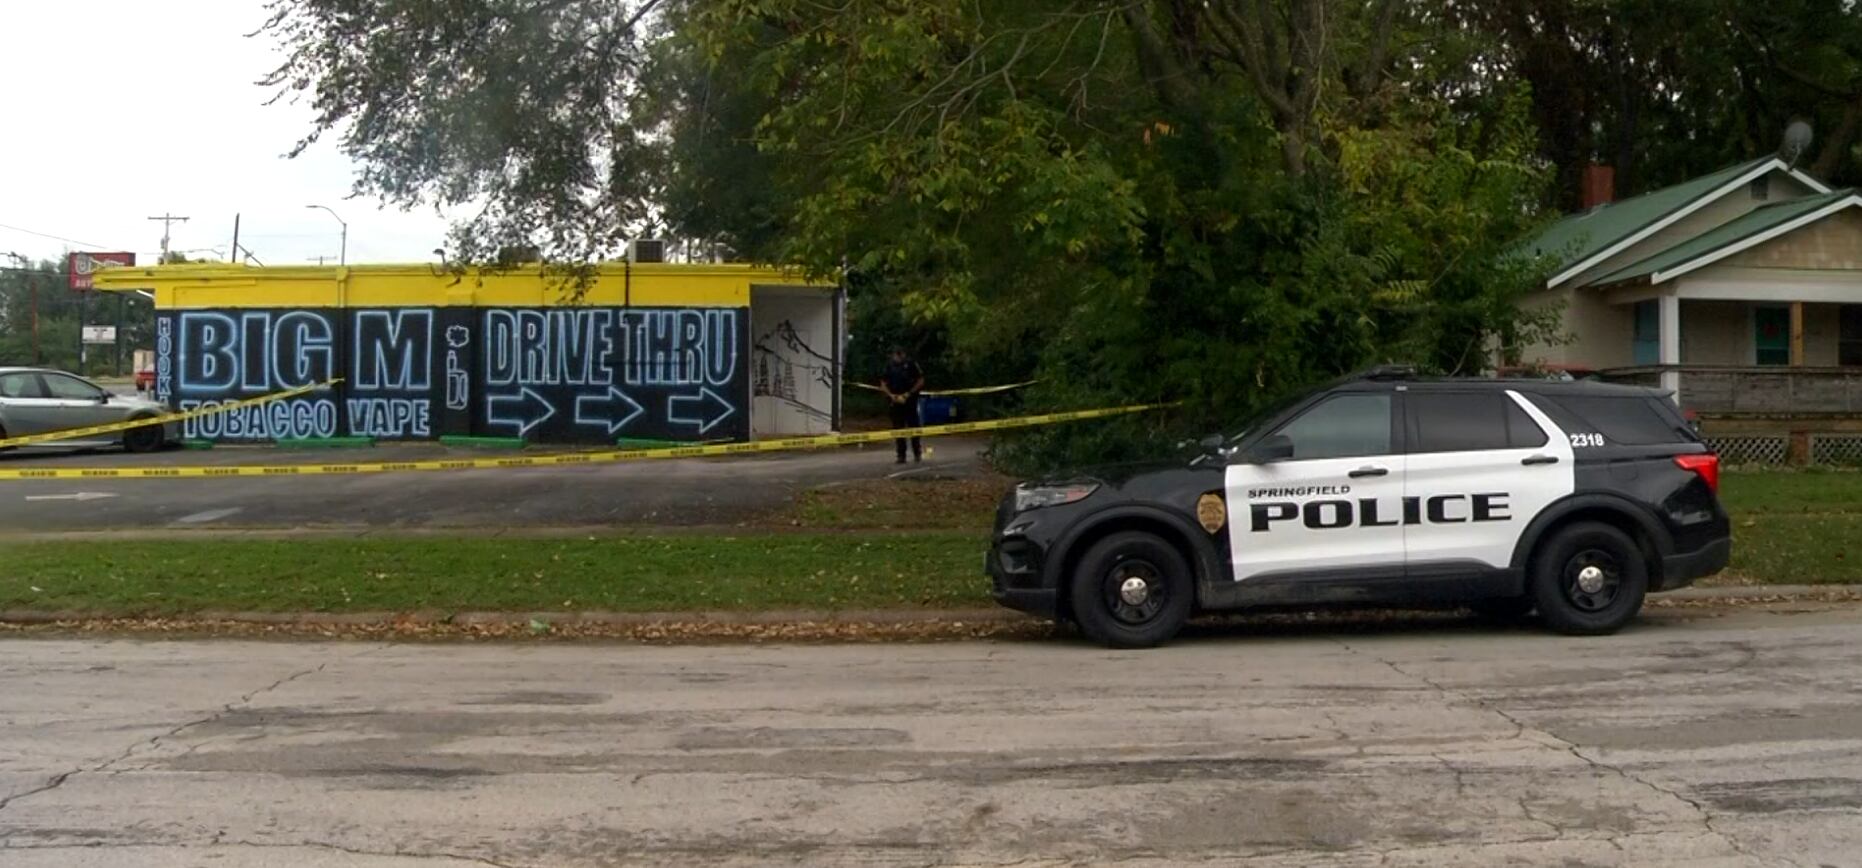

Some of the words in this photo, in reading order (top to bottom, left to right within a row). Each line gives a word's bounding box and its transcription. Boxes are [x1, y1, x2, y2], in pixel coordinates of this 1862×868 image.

[180, 311, 333, 392] BIG
[355, 309, 433, 390] M
[486, 309, 613, 386] DRIVE
[620, 309, 737, 387] THRU
[179, 399, 336, 438] TOBACCO
[347, 399, 430, 437] VAPE
[1570, 432, 1604, 448] 2318
[1247, 485, 1351, 499] SPRINGFIELD
[1250, 492, 1512, 533] POLICE
